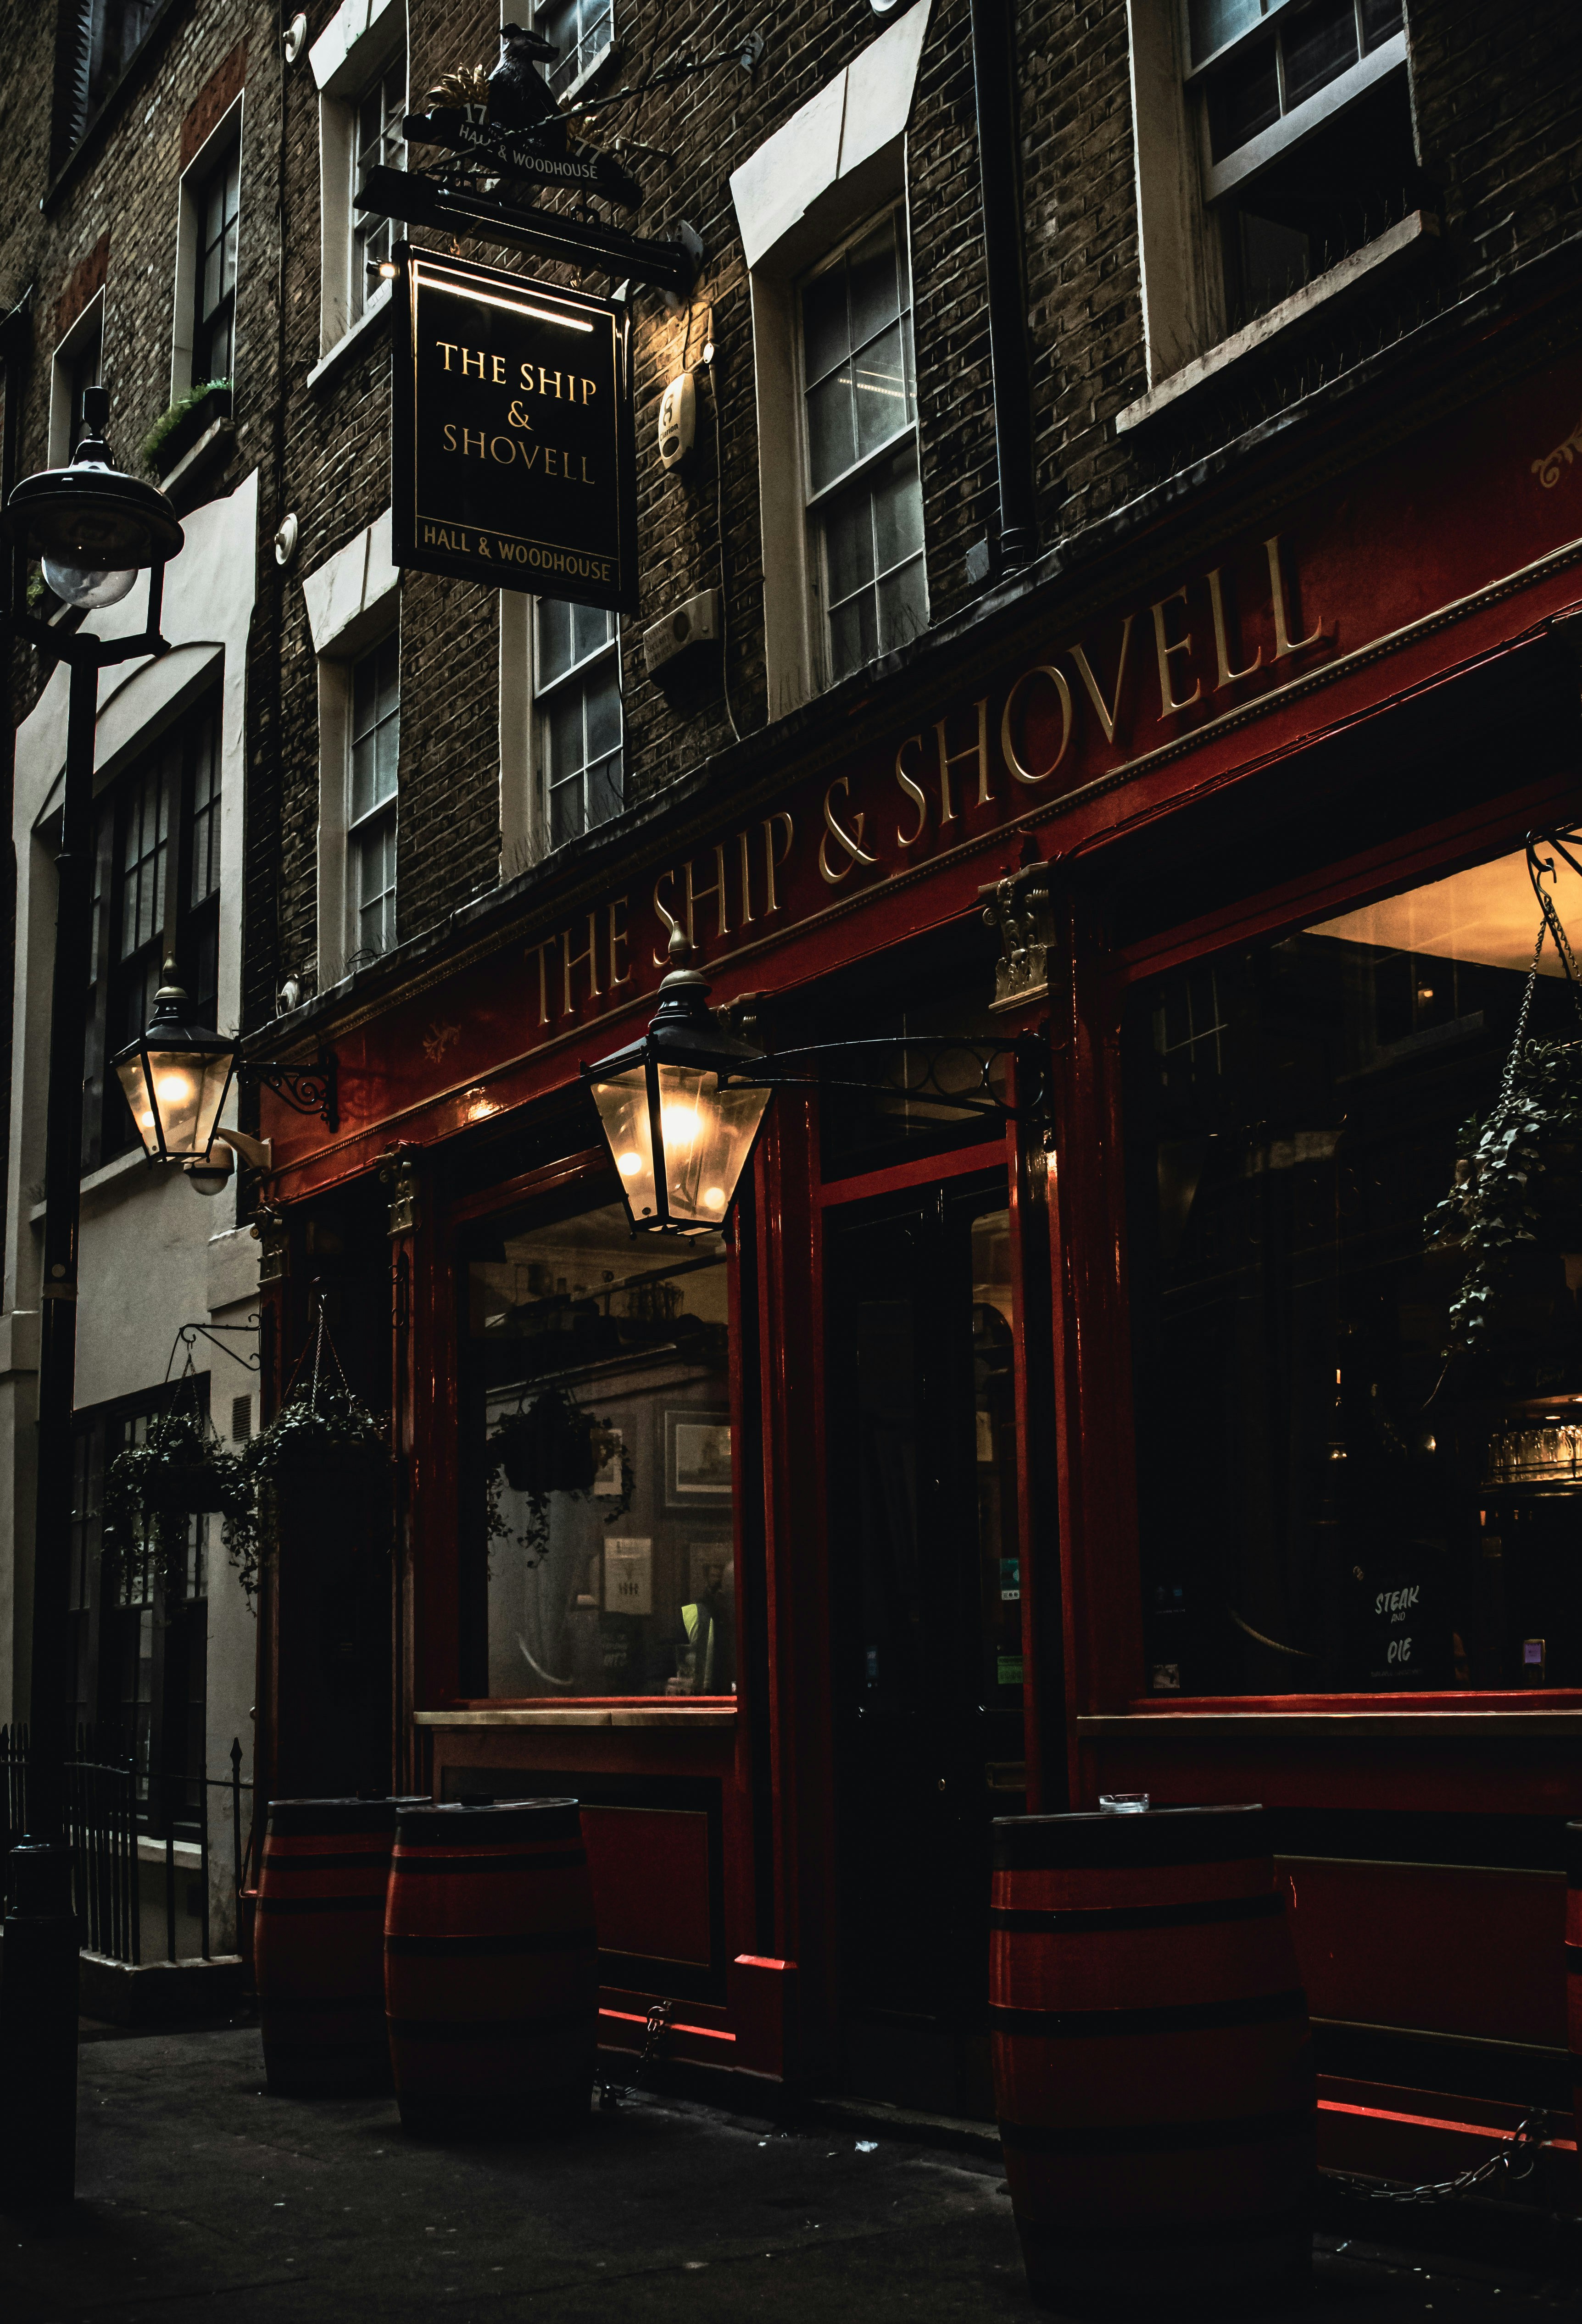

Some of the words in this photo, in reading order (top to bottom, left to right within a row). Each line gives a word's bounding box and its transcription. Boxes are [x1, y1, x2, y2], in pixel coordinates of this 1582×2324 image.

[463, 103, 487, 125] 17
[498, 145, 507, 161] &
[513, 150, 598, 179] WOODHOUSE
[436, 341, 507, 385] THE
[520, 363, 596, 406] SHIP
[507, 400, 534, 431] &
[660, 423, 678, 441] Clarion
[443, 424, 595, 484] SHOVELL
[424, 524, 471, 552] HALL
[478, 536, 492, 559] &
[498, 540, 611, 582] WOODHOUSE
[524, 895, 630, 1027] THE
[653, 812, 793, 968] SHIP
[819, 776, 880, 884] &
[895, 534, 1323, 848] SHOVELL
[1375, 1585, 1420, 1614] STEAK
[1391, 1611, 1405, 1624] AND
[1387, 1637, 1412, 1663] PIE
